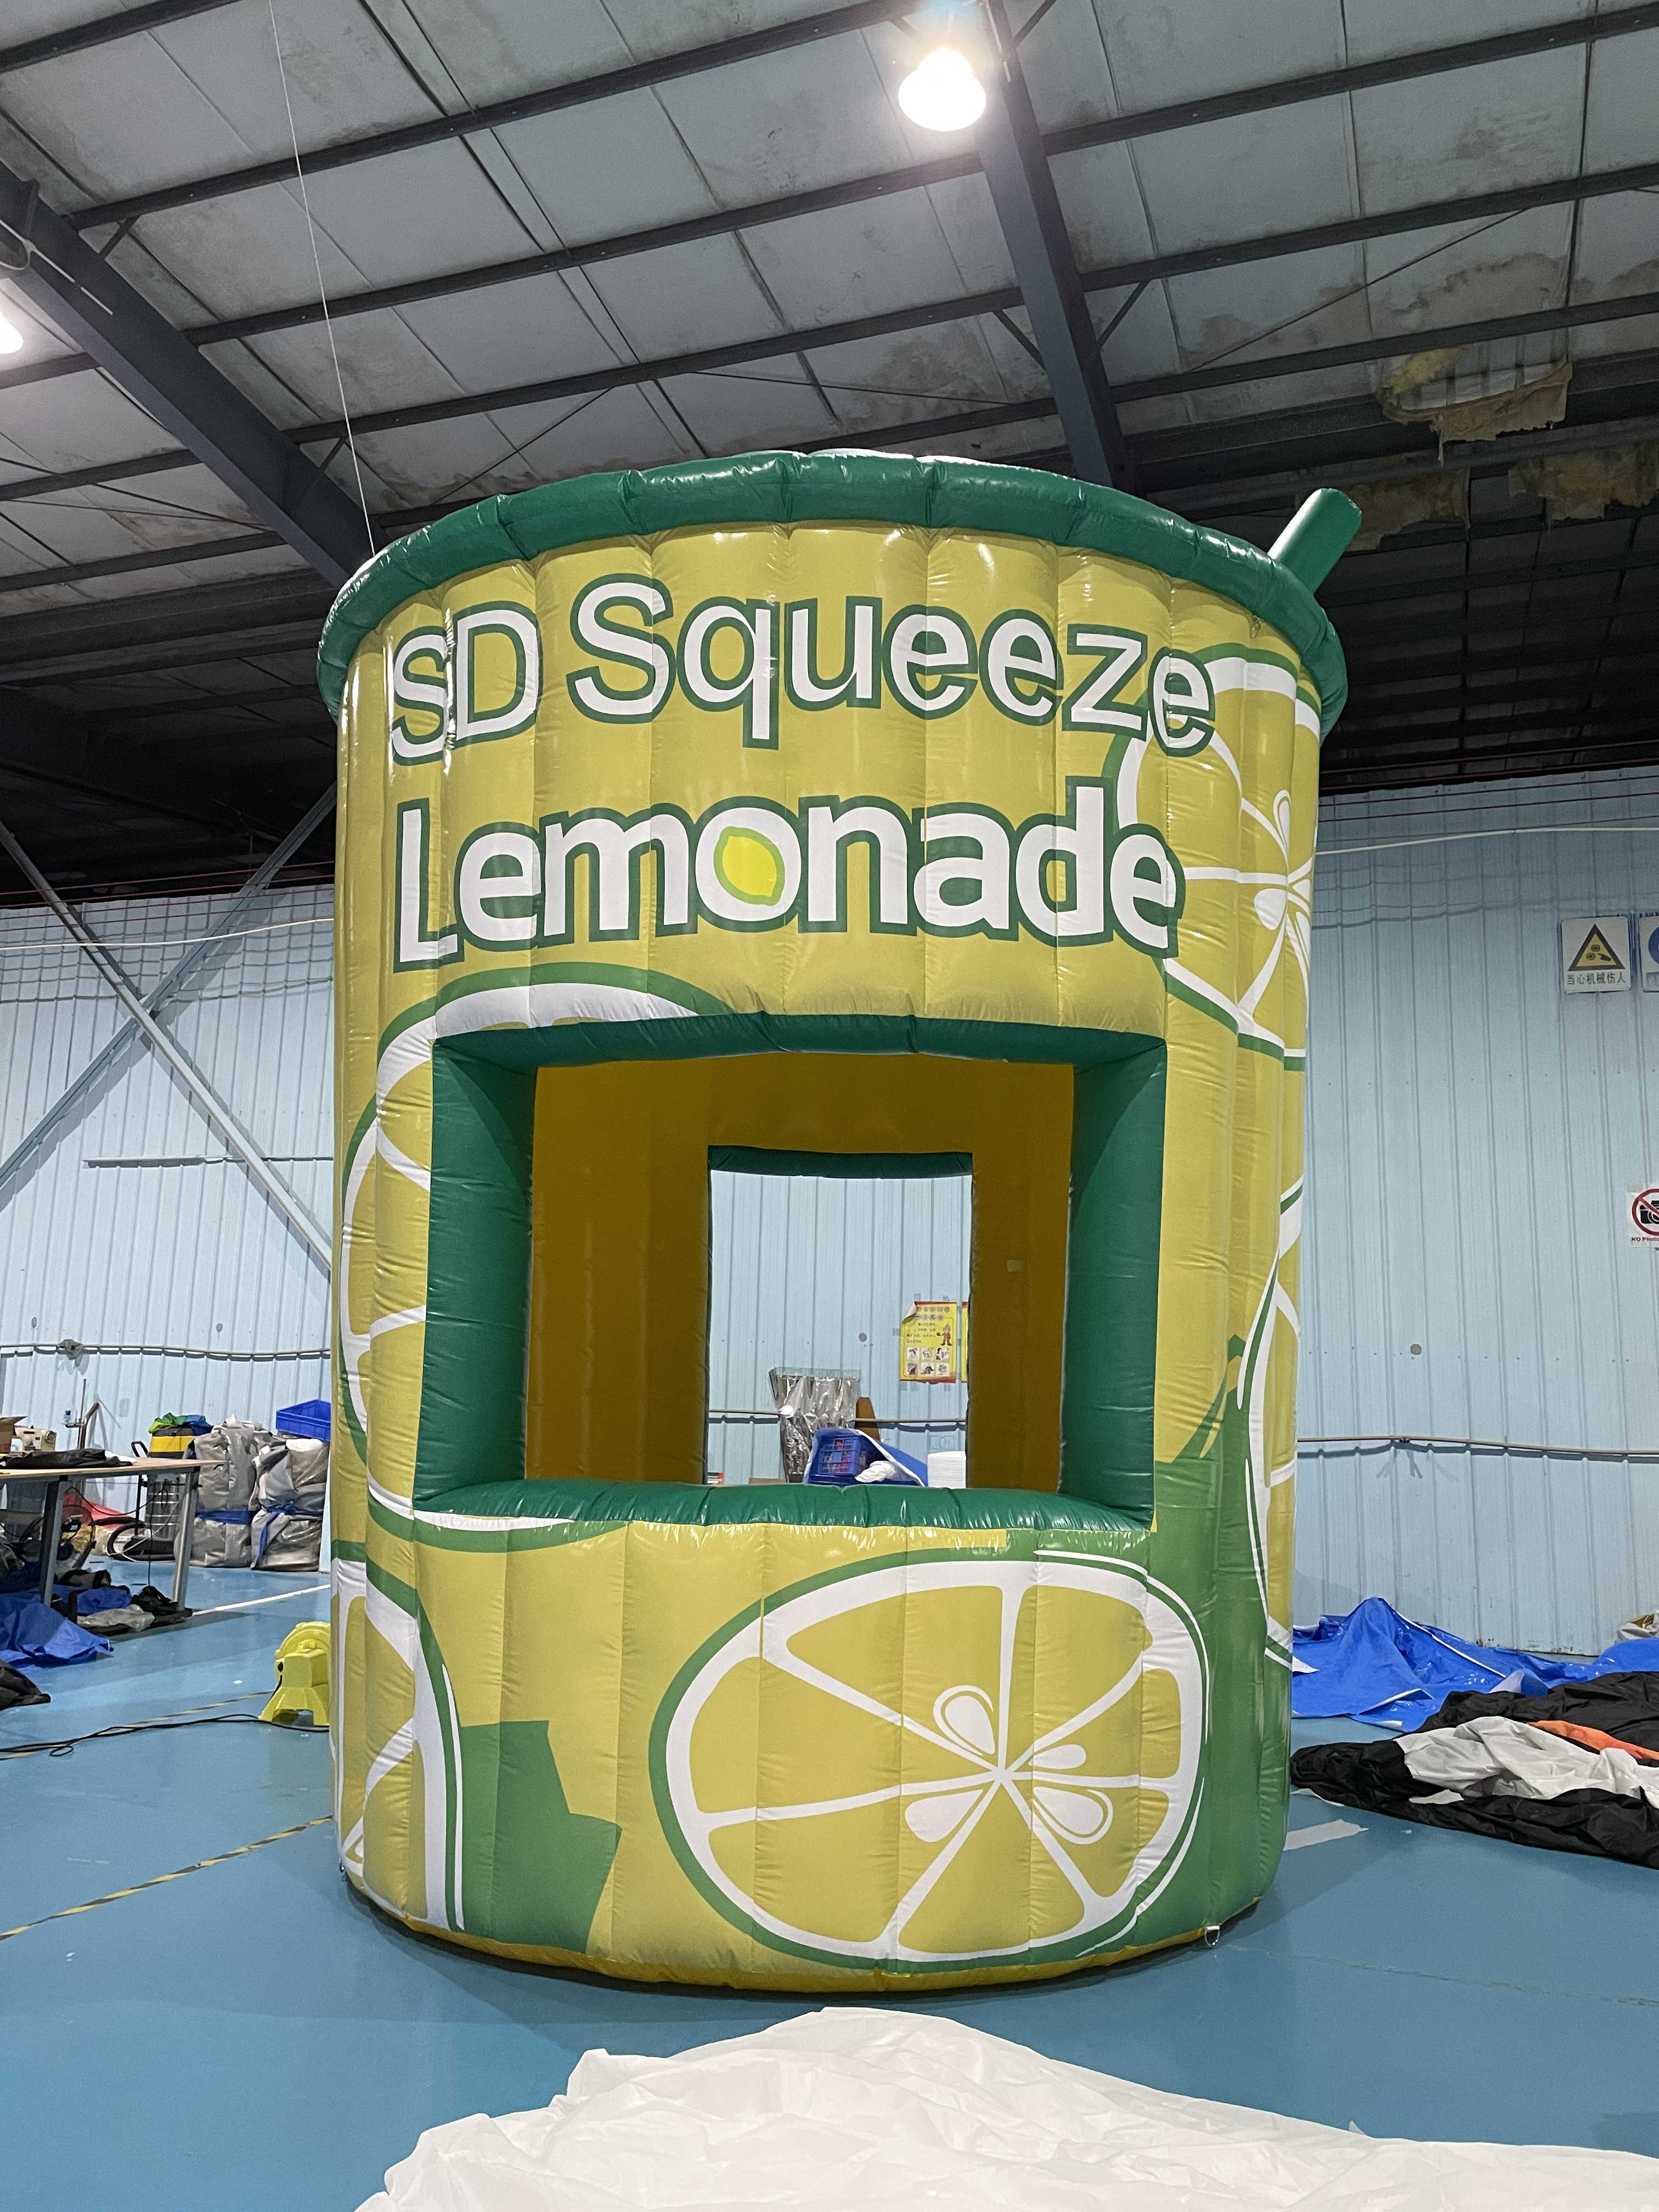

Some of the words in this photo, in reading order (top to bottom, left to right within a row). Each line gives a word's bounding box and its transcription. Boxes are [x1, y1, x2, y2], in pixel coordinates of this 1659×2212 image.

[391, 600, 544, 766] SD
[566, 573, 1215, 757] Squeeze
[393, 776, 1186, 974] Lemonade
[1567, 972, 1626, 985] 当心机械伤人
